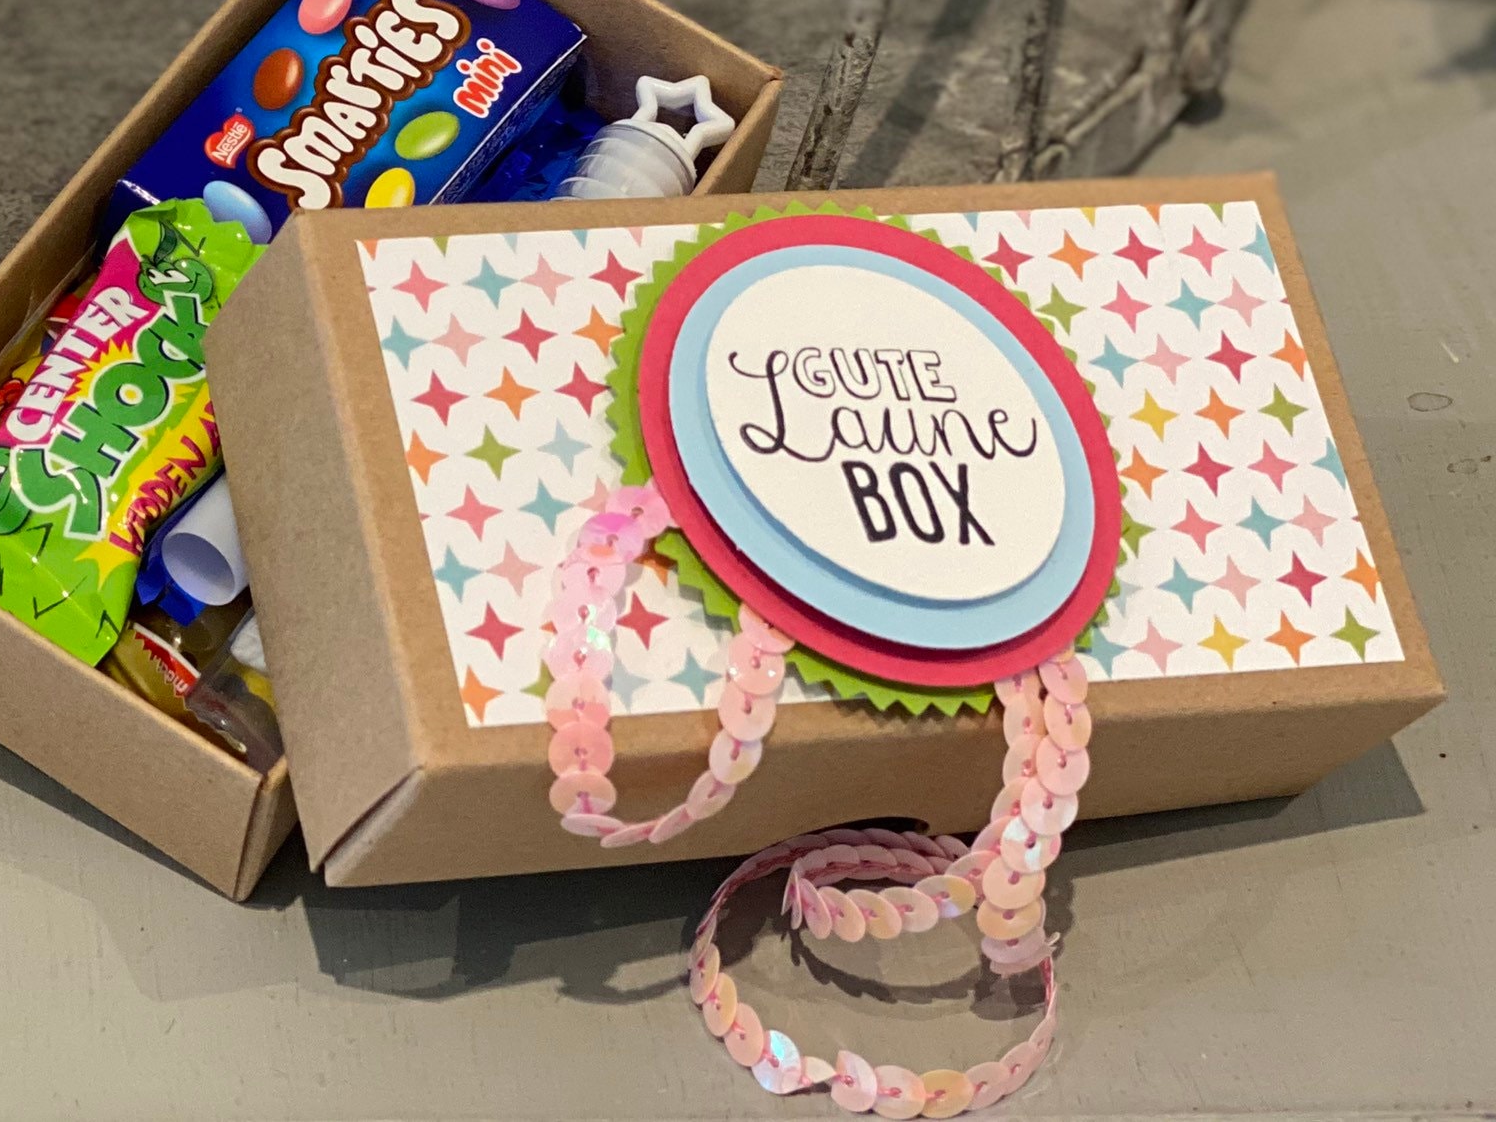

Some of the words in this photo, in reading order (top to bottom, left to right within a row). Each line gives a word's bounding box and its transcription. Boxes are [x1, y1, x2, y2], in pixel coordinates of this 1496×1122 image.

[454, 38, 522, 118] mini
[5, 286, 150, 442] CENTER
[727, 349, 1038, 462] Laune
[792, 346, 957, 403] GUTE
[12, 291, 208, 539] SHOCK
[841, 460, 996, 547] BOX
